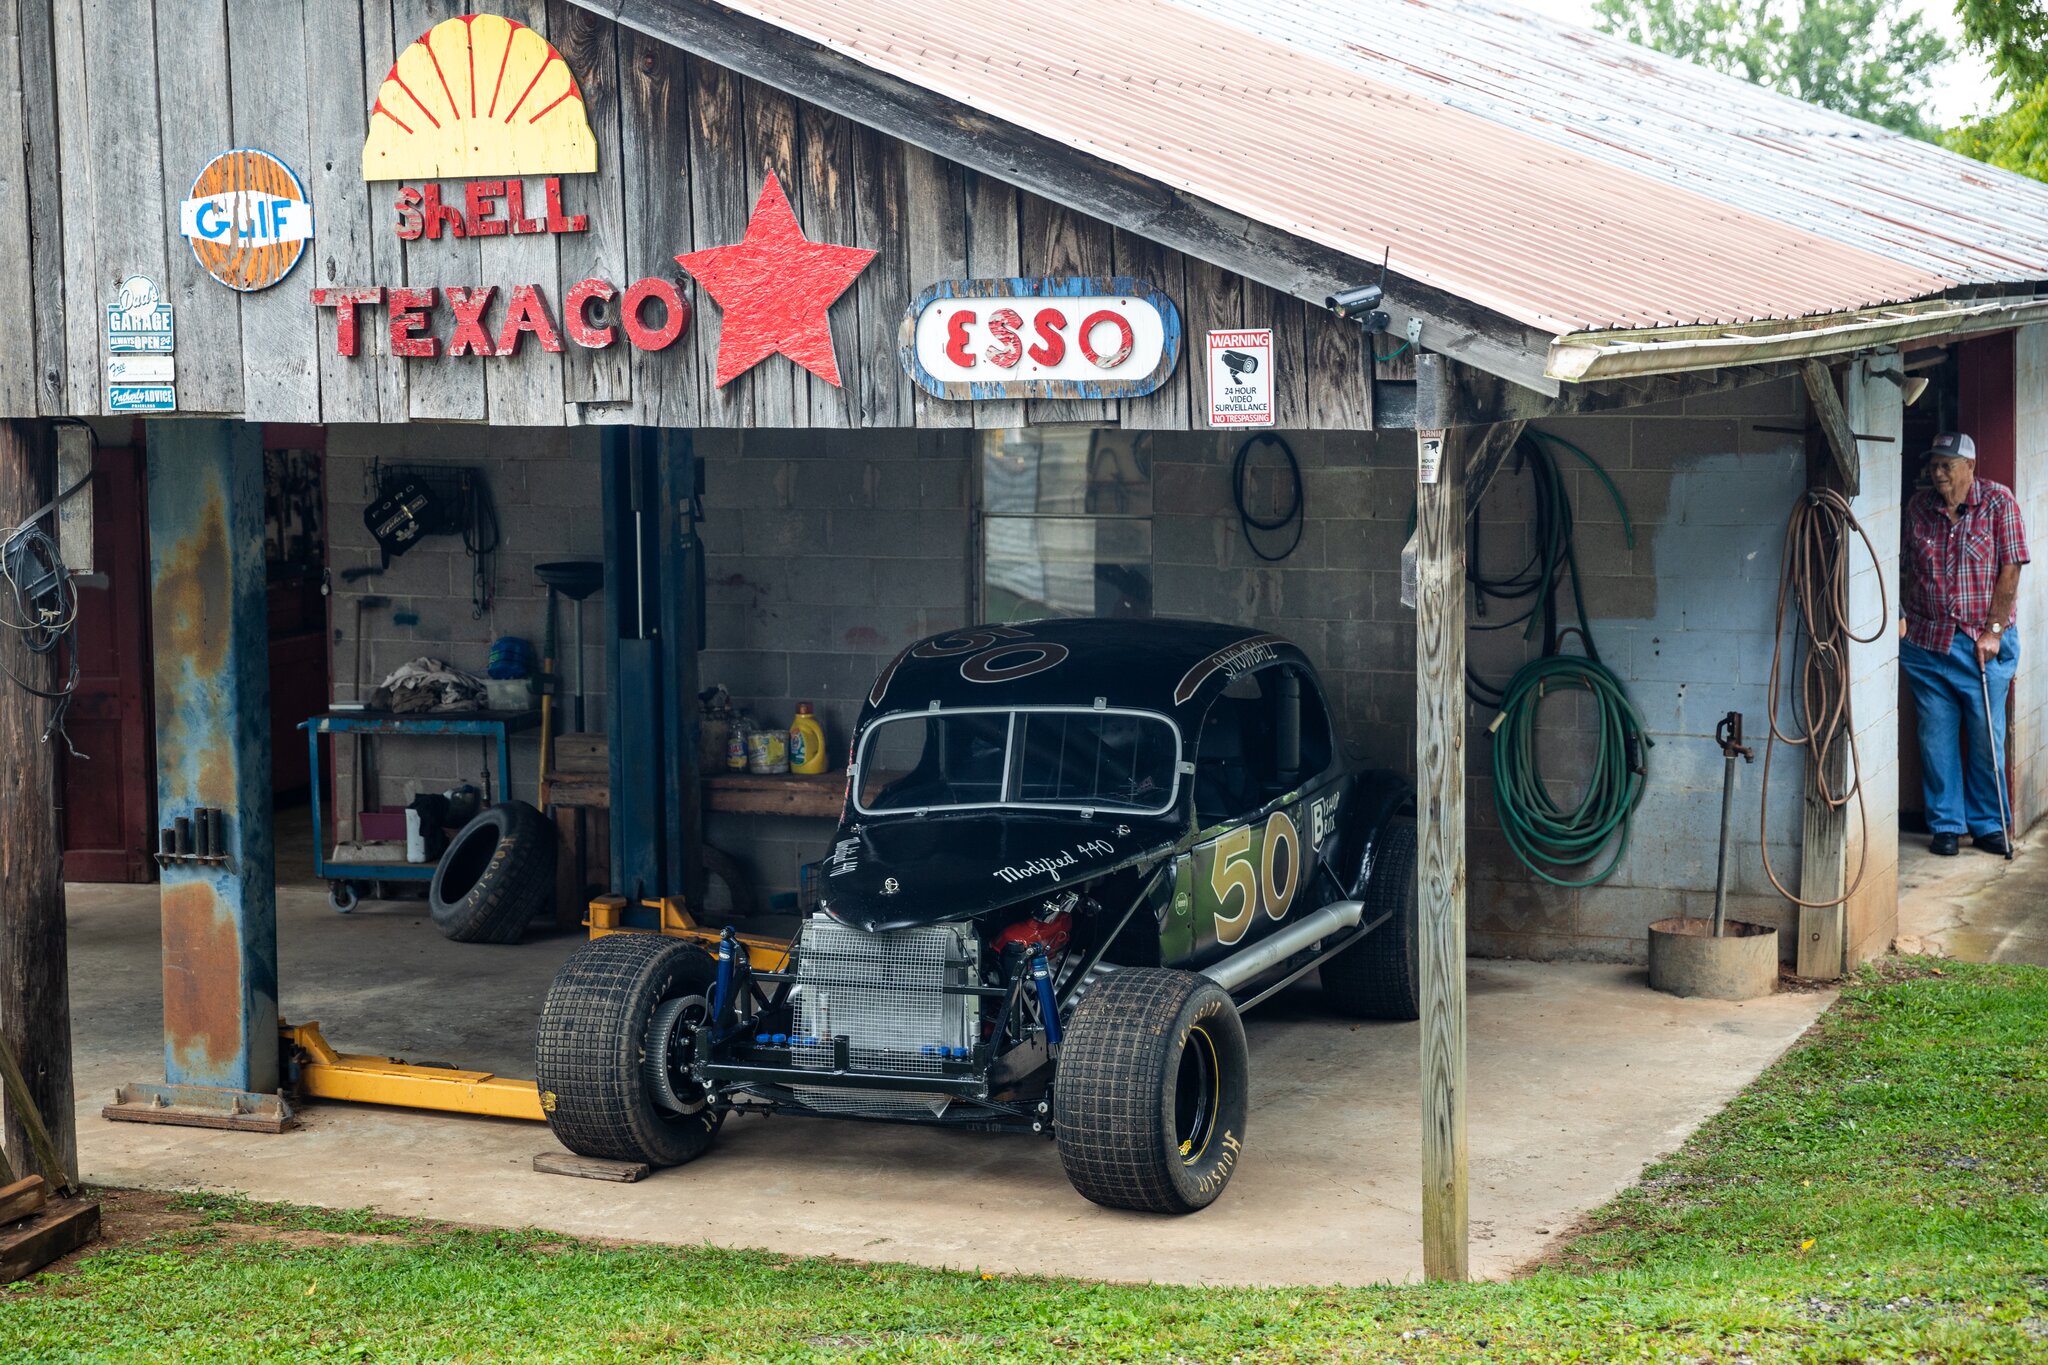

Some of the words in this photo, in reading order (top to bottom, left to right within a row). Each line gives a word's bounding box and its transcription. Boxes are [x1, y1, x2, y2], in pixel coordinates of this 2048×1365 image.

[119, 284, 160, 312] Dad's
[110, 312, 171, 331] GARAGE
[309, 276, 692, 357] TEXACO
[110, 336, 135, 345] ALWAYS
[134, 336, 160, 350] OPEN
[160, 336, 172, 346] 24
[945, 306, 1135, 370] ESSO
[1210, 333, 1269, 347] WARNING
[111, 388, 145, 405] Fatherly
[143, 390, 173, 403] ADVICE
[1224, 387, 1234, 395] 24
[1234, 386, 1257, 395] HOUR
[1229, 395, 1253, 403] VIDEO
[1215, 403, 1268, 412] SURVEILLANCE
[1214, 414, 1225, 423] NO
[1226, 413, 1270, 423] TRESPASSING
[1212, 640, 1278, 678] SNOWBALL
[992, 850, 1079, 883] Modified
[1076, 839, 1115, 859] 440
[1210, 811, 1300, 946] 50
